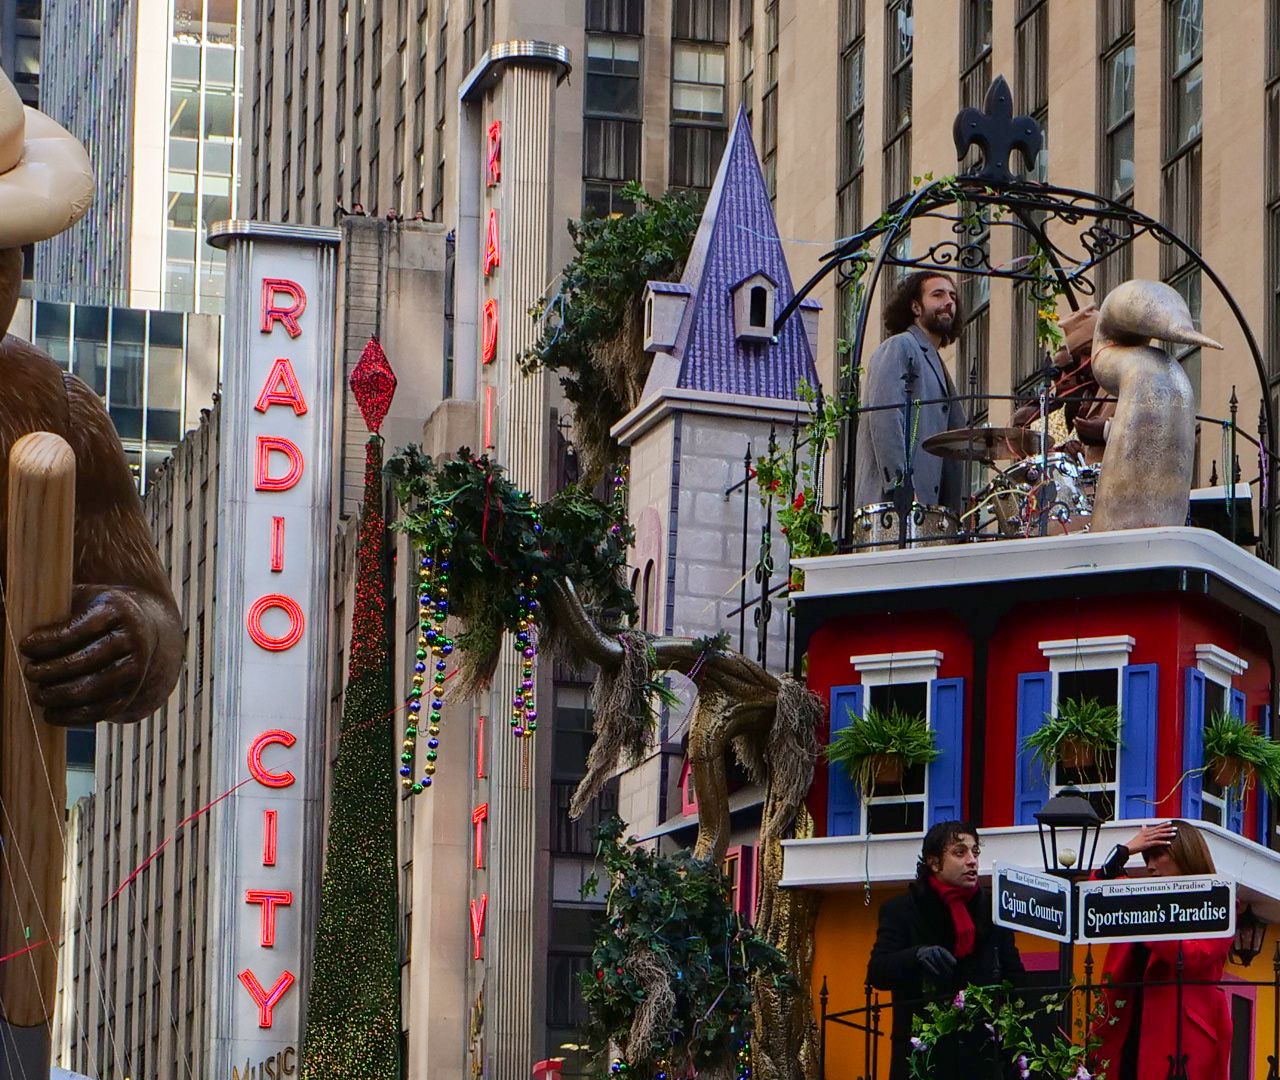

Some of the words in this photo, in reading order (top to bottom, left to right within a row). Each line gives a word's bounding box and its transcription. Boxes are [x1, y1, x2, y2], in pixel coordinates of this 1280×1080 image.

[481, 120, 501, 449] RADI
[247, 278, 308, 652] RADIO
[238, 728, 297, 1029] CITY
[470, 716, 488, 961] ITY
[1002, 890, 1027, 918] Cajun
[1029, 897, 1064, 930] Country
[1087, 904, 1166, 933] Sportsman's
[1170, 901, 1227, 923] Paradise
[1109, 885, 1123, 895] Rue
[1125, 883, 1170, 895] Sportsman's
[1173, 881, 1206, 891] Paradise
